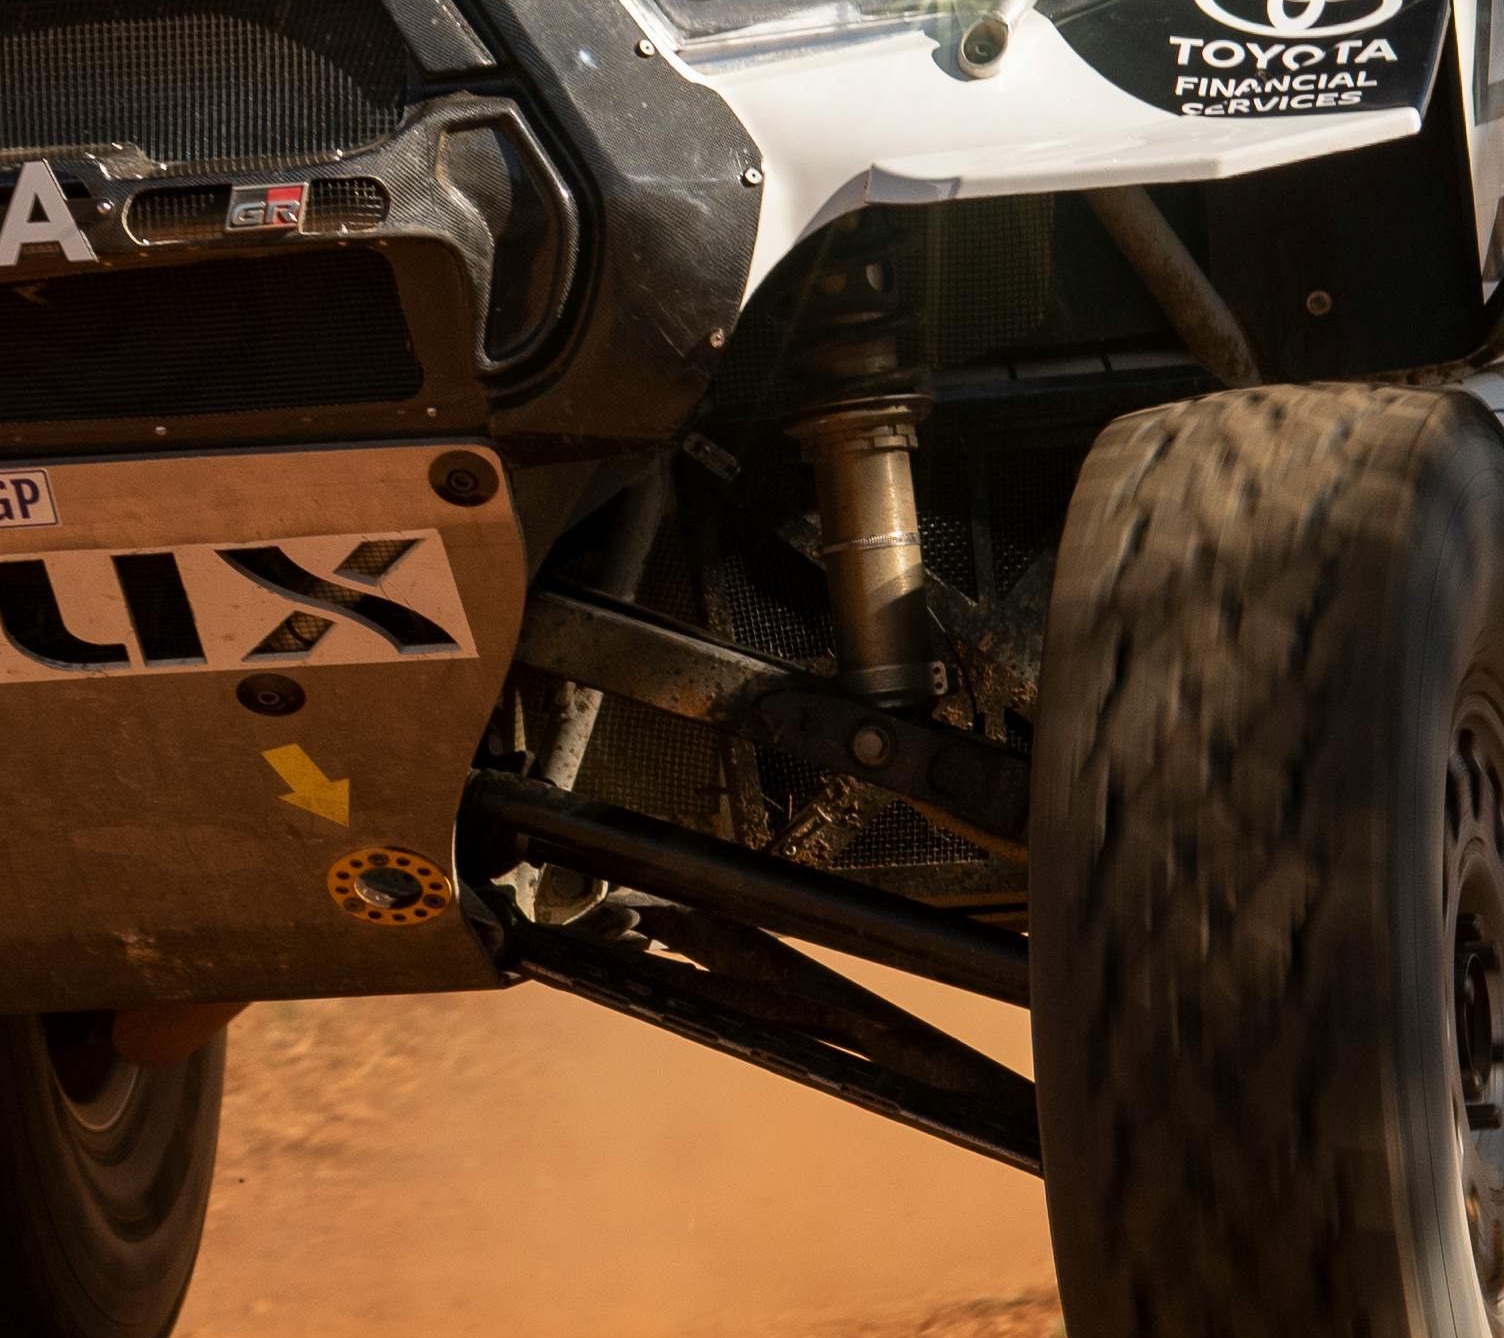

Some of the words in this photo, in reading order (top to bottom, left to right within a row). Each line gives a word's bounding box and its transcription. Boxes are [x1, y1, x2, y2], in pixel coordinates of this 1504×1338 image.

[1169, 36, 1398, 71] TOYOTA
[1174, 71, 1378, 98] FINANCIAL
[232, 200, 301, 226] GR
